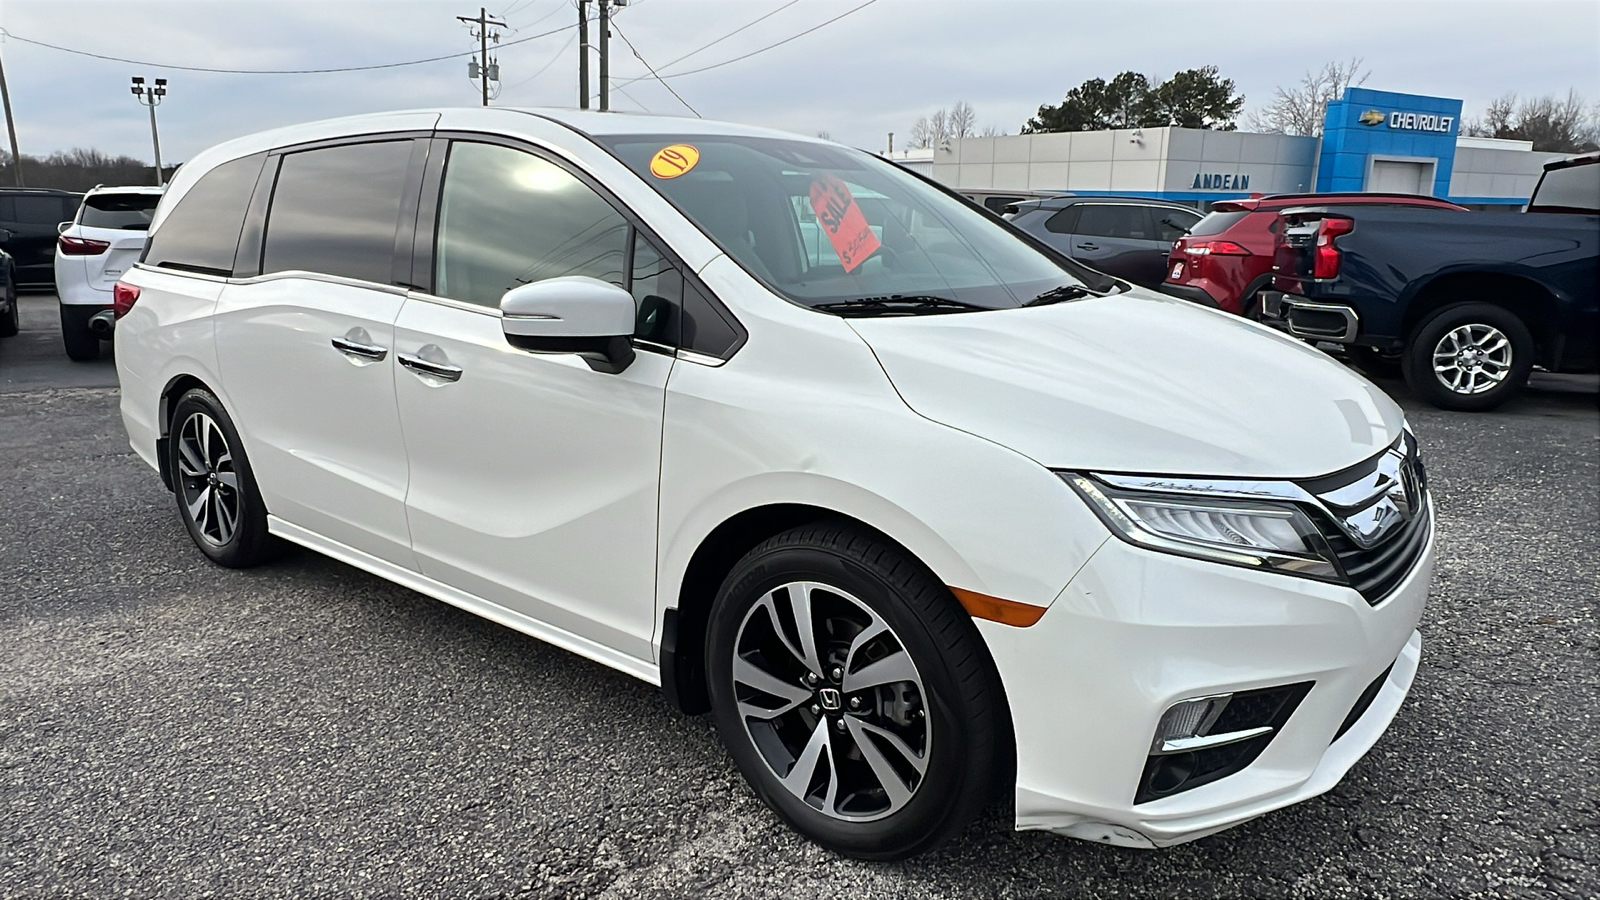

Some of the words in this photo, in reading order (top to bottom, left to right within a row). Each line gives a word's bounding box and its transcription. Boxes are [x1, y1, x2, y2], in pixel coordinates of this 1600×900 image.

[1390, 111, 1454, 132] CHEVROLET
[658, 149, 689, 172] 19
[1192, 173, 1250, 190] ANDEAN
[821, 184, 852, 234] SALE
